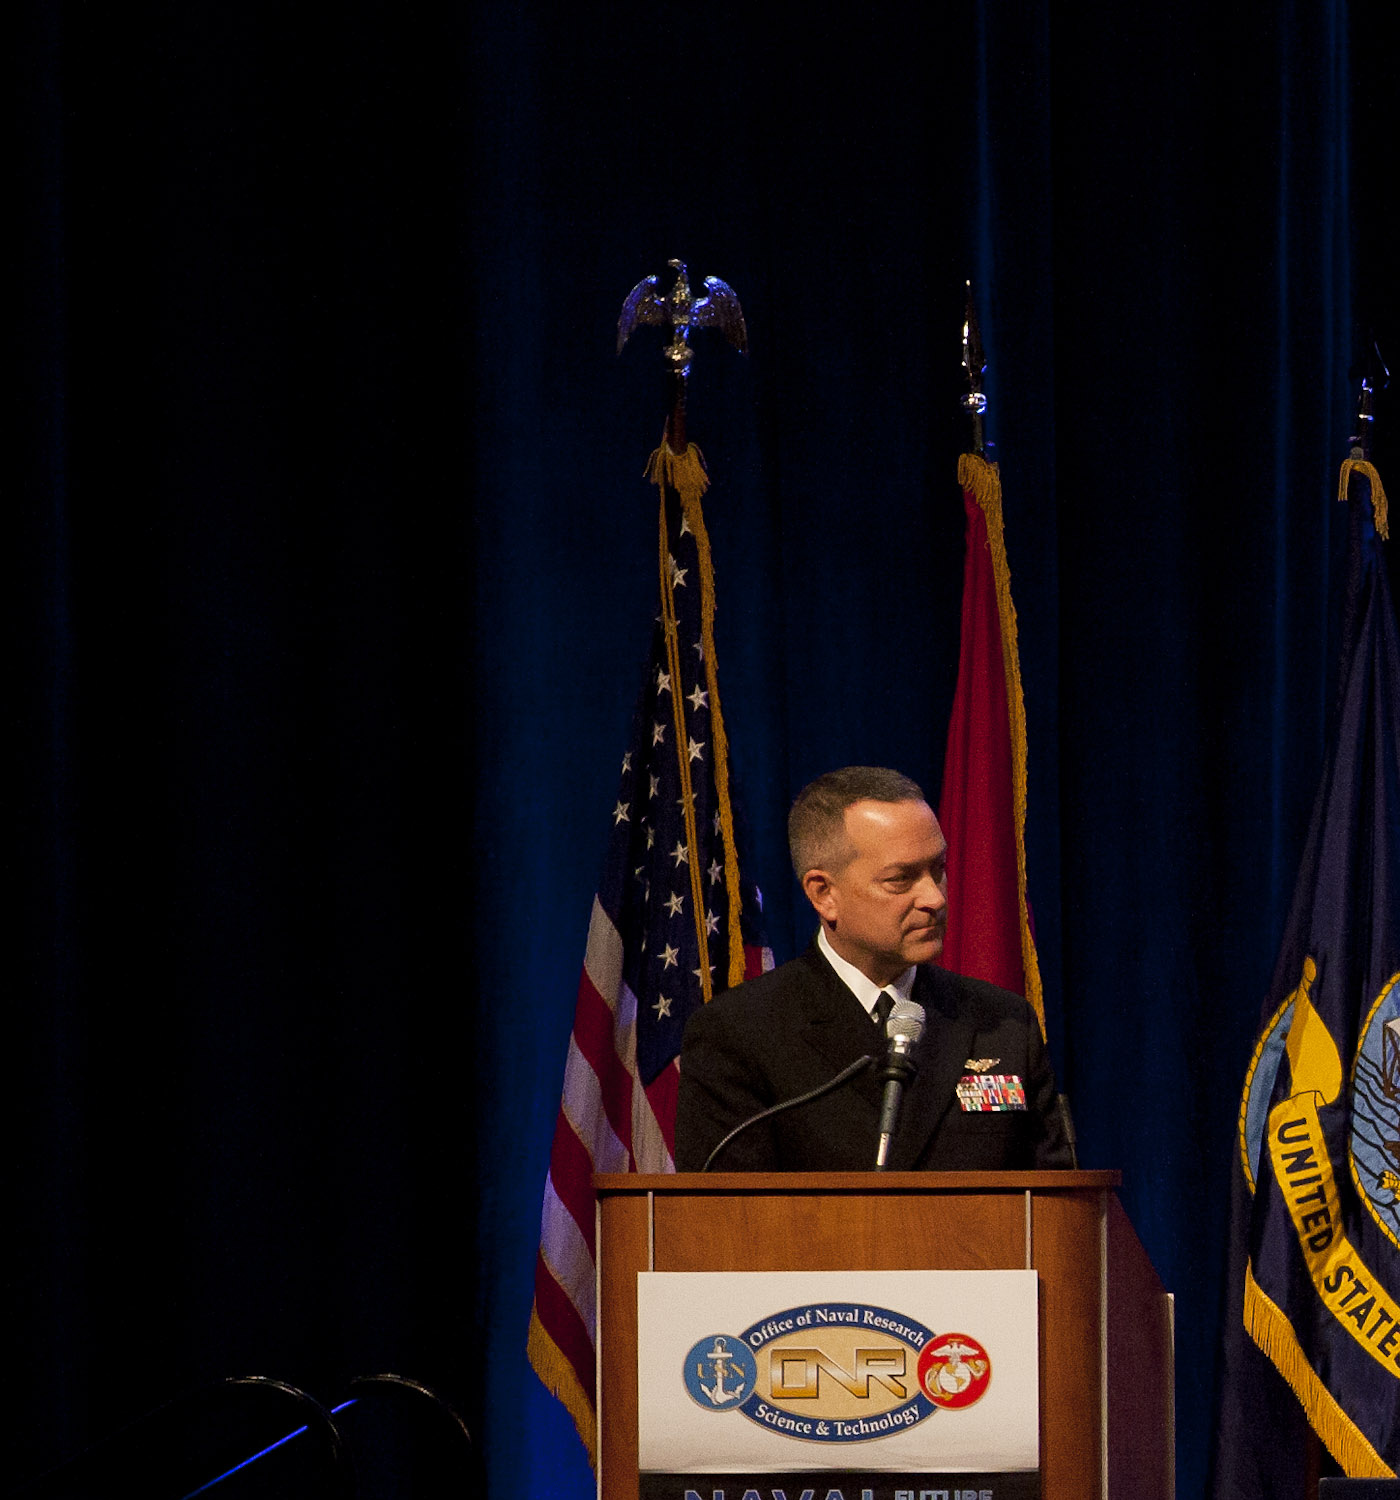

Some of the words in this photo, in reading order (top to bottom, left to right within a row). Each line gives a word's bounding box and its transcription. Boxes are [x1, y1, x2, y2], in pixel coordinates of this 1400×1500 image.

[1277, 1117, 1335, 1253] UNITED
[750, 1318, 794, 1348] Office
[797, 1310, 811, 1326] of
[816, 1309, 858, 1323] Naval
[864, 1311, 924, 1346] Research
[771, 1349, 907, 1399] ONR
[756, 1405, 811, 1435] Science
[816, 1421, 829, 1436] &
[834, 1404, 920, 1436] Technology
